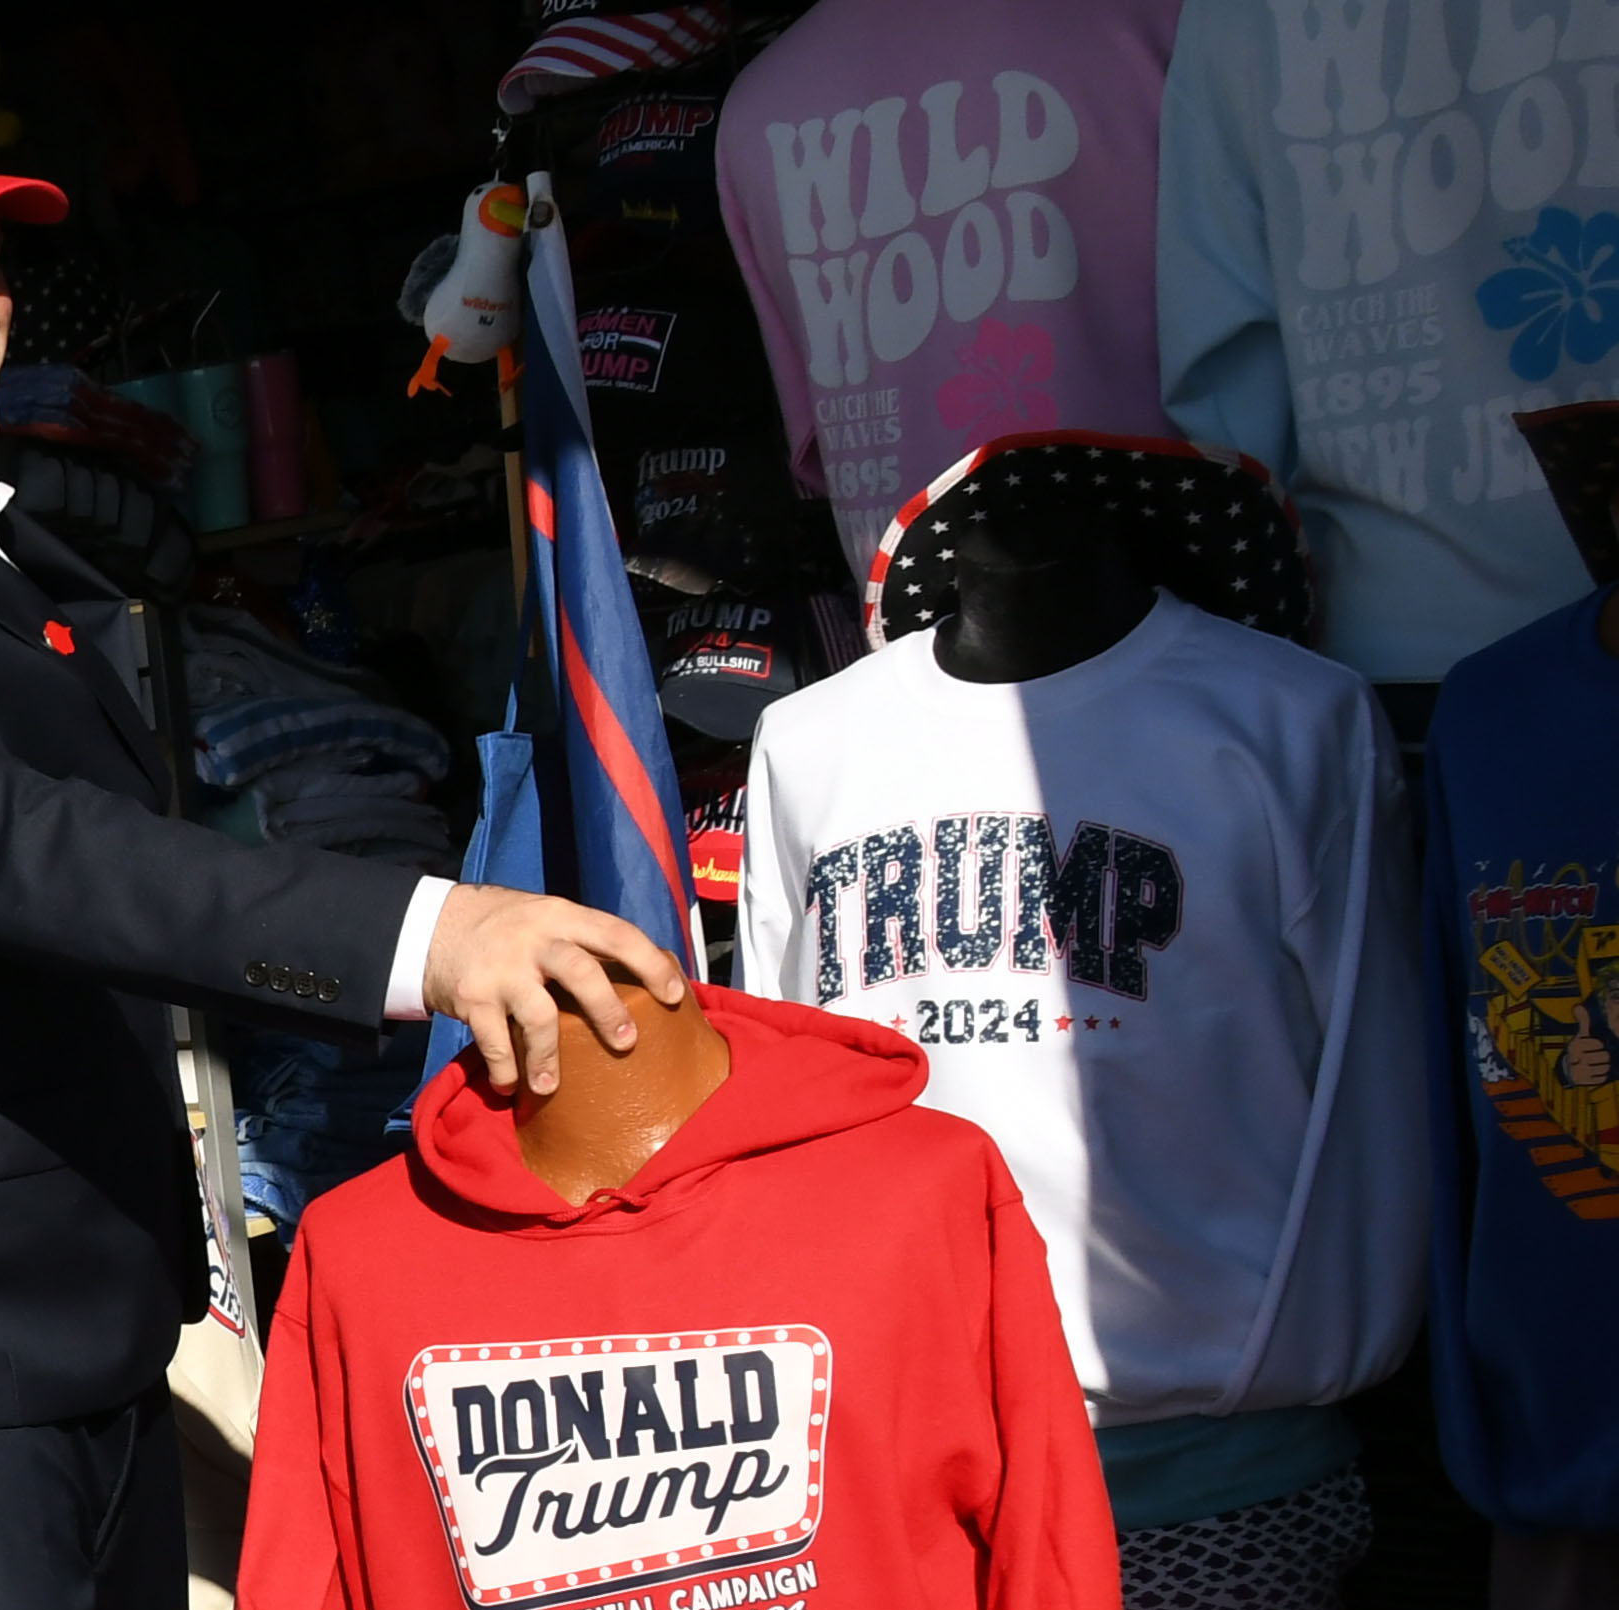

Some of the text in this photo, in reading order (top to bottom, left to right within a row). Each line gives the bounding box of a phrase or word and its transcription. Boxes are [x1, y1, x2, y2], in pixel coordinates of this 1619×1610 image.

[765, 69, 1080, 256] WILD
[788, 191, 1079, 389] WOOD
[1297, 283, 1440, 336] CATCH THE
[478, 315, 495, 327] NJ
[582, 331, 621, 351] FOR
[1304, 315, 1445, 365] WAVES
[584, 351, 651, 382] UMP
[1296, 359, 1444, 419] 1895
[824, 415, 903, 451] WAVES
[825, 456, 903, 500] 1895
[641, 494, 699, 528] 2024
[666, 602, 773, 640] TRUMP
[697, 655, 763, 673] BULLSHIT
[805, 811, 1185, 1012] TRUMP
[916, 998, 1042, 1045] 2024
[453, 1350, 780, 1475] DONALD
[474, 1438, 790, 1556] Trump
